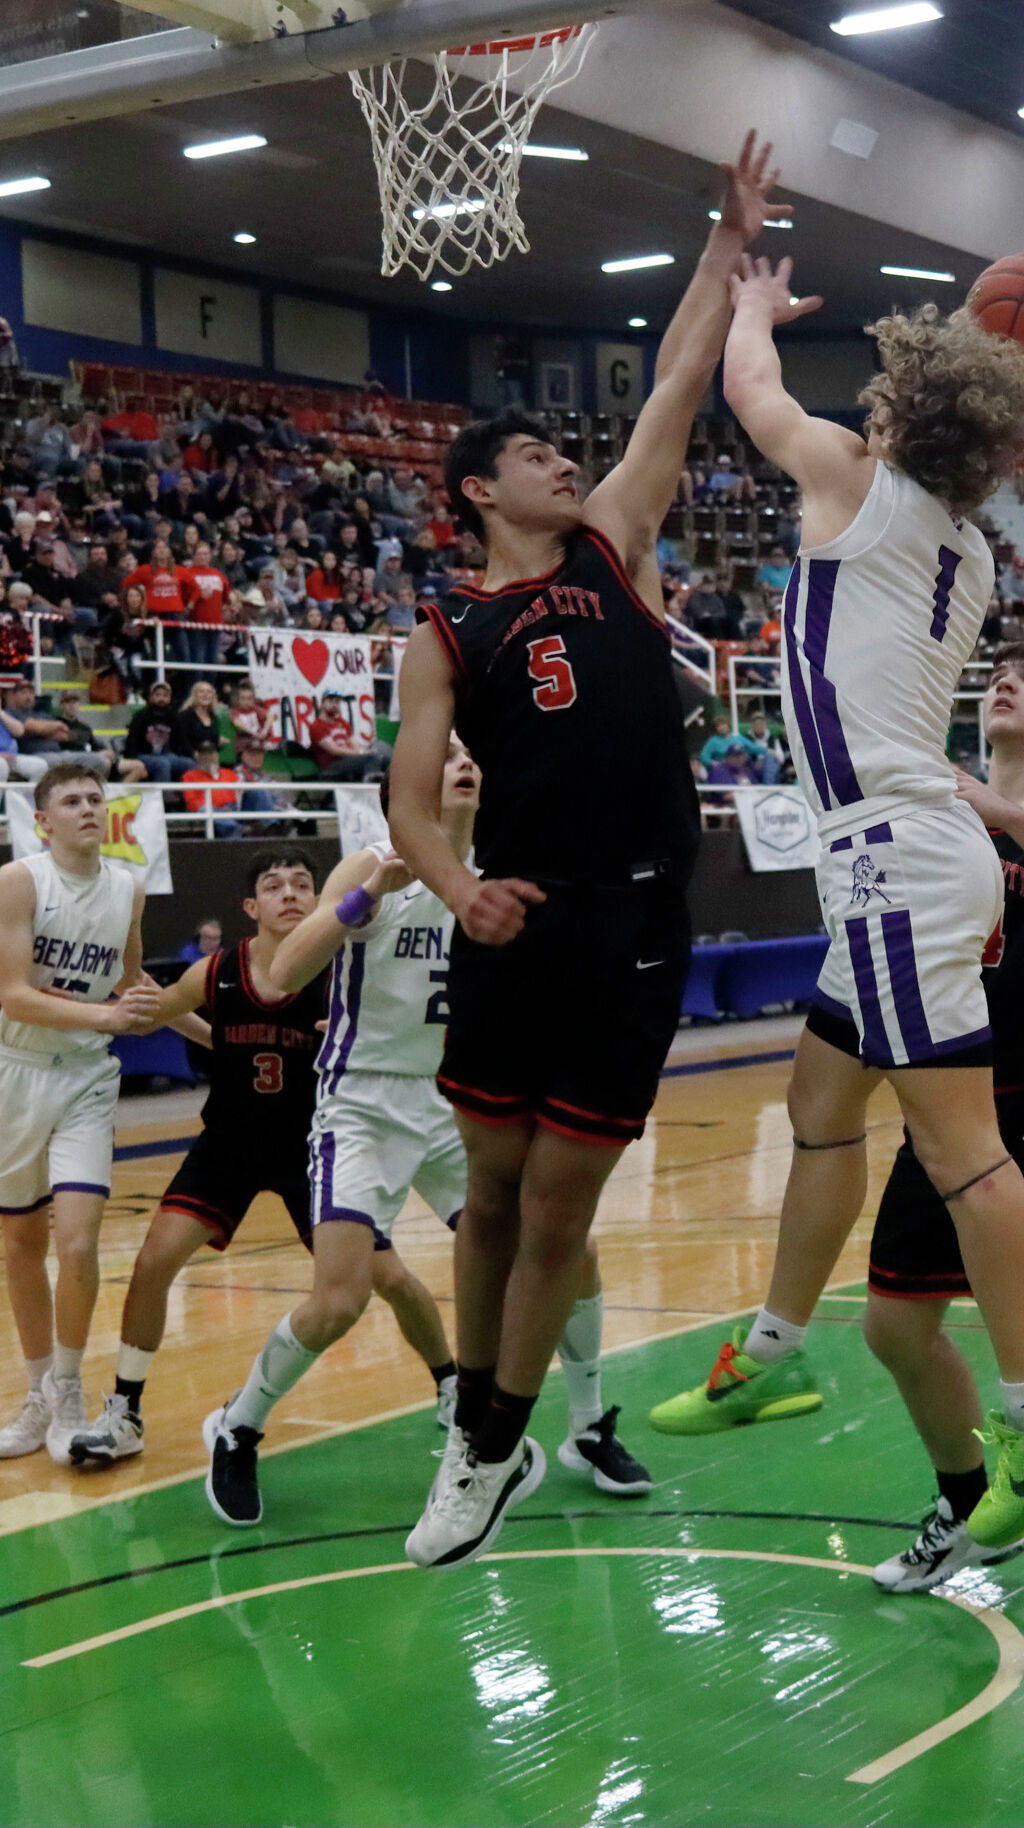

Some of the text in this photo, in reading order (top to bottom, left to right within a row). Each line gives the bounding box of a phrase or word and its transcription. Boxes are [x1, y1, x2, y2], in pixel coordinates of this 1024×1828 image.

[200, 295, 217, 338] F
[610, 360, 630, 398] G
[549, 585, 605, 620] CITY
[930, 544, 963, 643] 1
[250, 635, 367, 675] WE OUR
[526, 634, 577, 712] 5
[253, 1052, 283, 1094] 3
